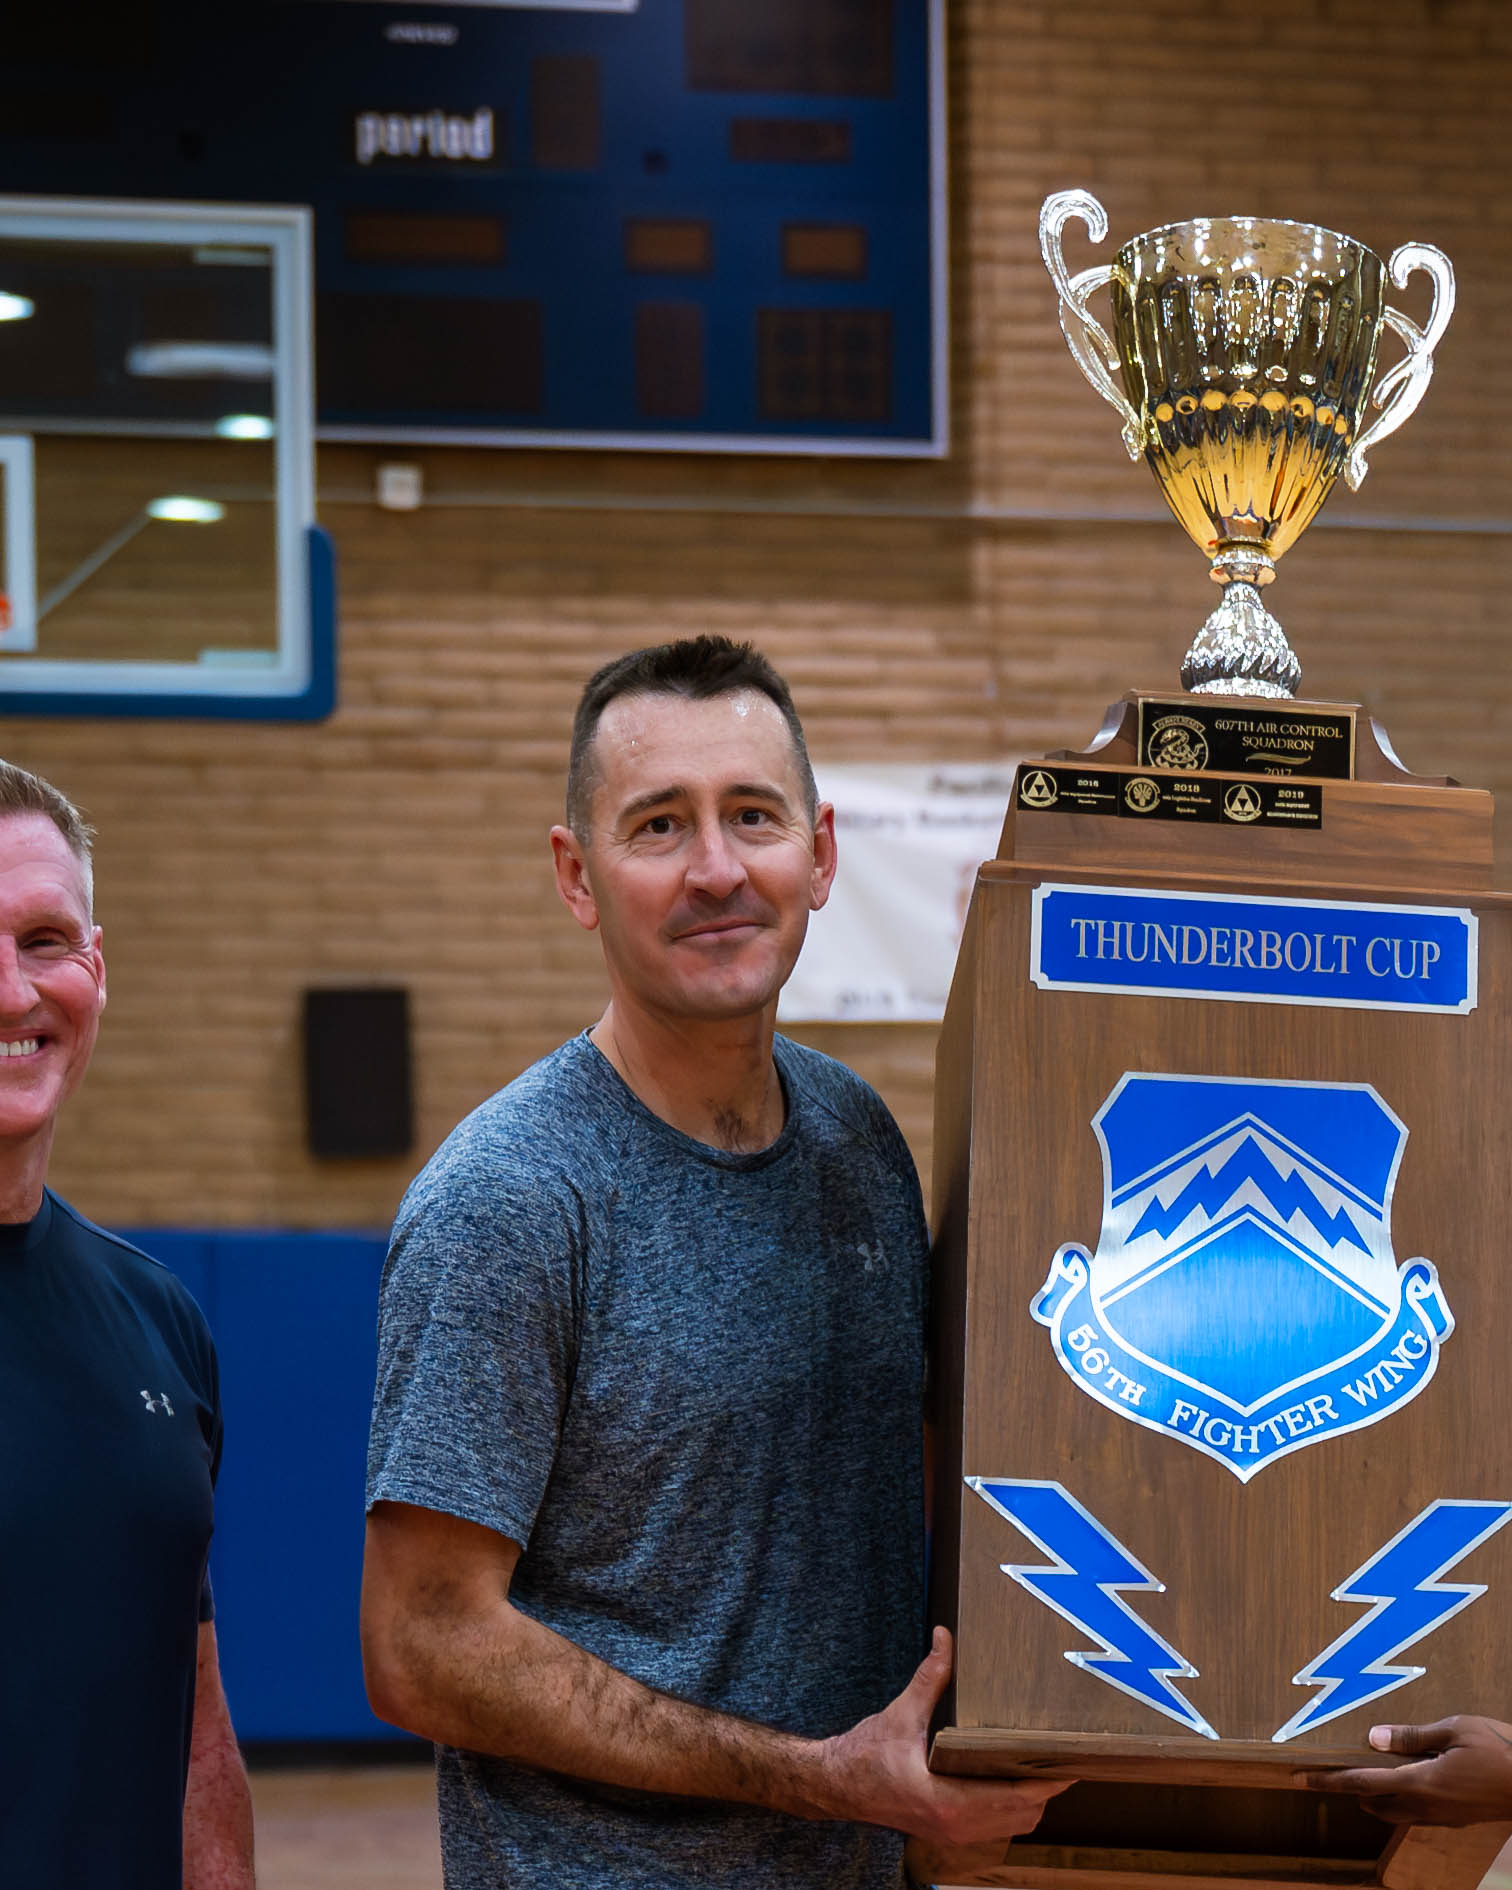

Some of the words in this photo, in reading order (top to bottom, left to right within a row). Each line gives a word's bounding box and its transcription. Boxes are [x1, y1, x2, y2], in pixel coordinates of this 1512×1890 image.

[356, 107, 494, 164] period
[1215, 719, 1254, 733] 607TH
[1256, 721, 1278, 735] AIR
[1280, 723, 1343, 739] CONTROL
[1242, 736, 1314, 751] SQUADRON
[1070, 917, 1356, 974] THUNDERBOLT
[1366, 937, 1441, 980] CUP
[1068, 1324, 1147, 1406] 56TH
[1168, 1394, 1339, 1454] FIGHTER
[1341, 1329, 1428, 1407] WING
